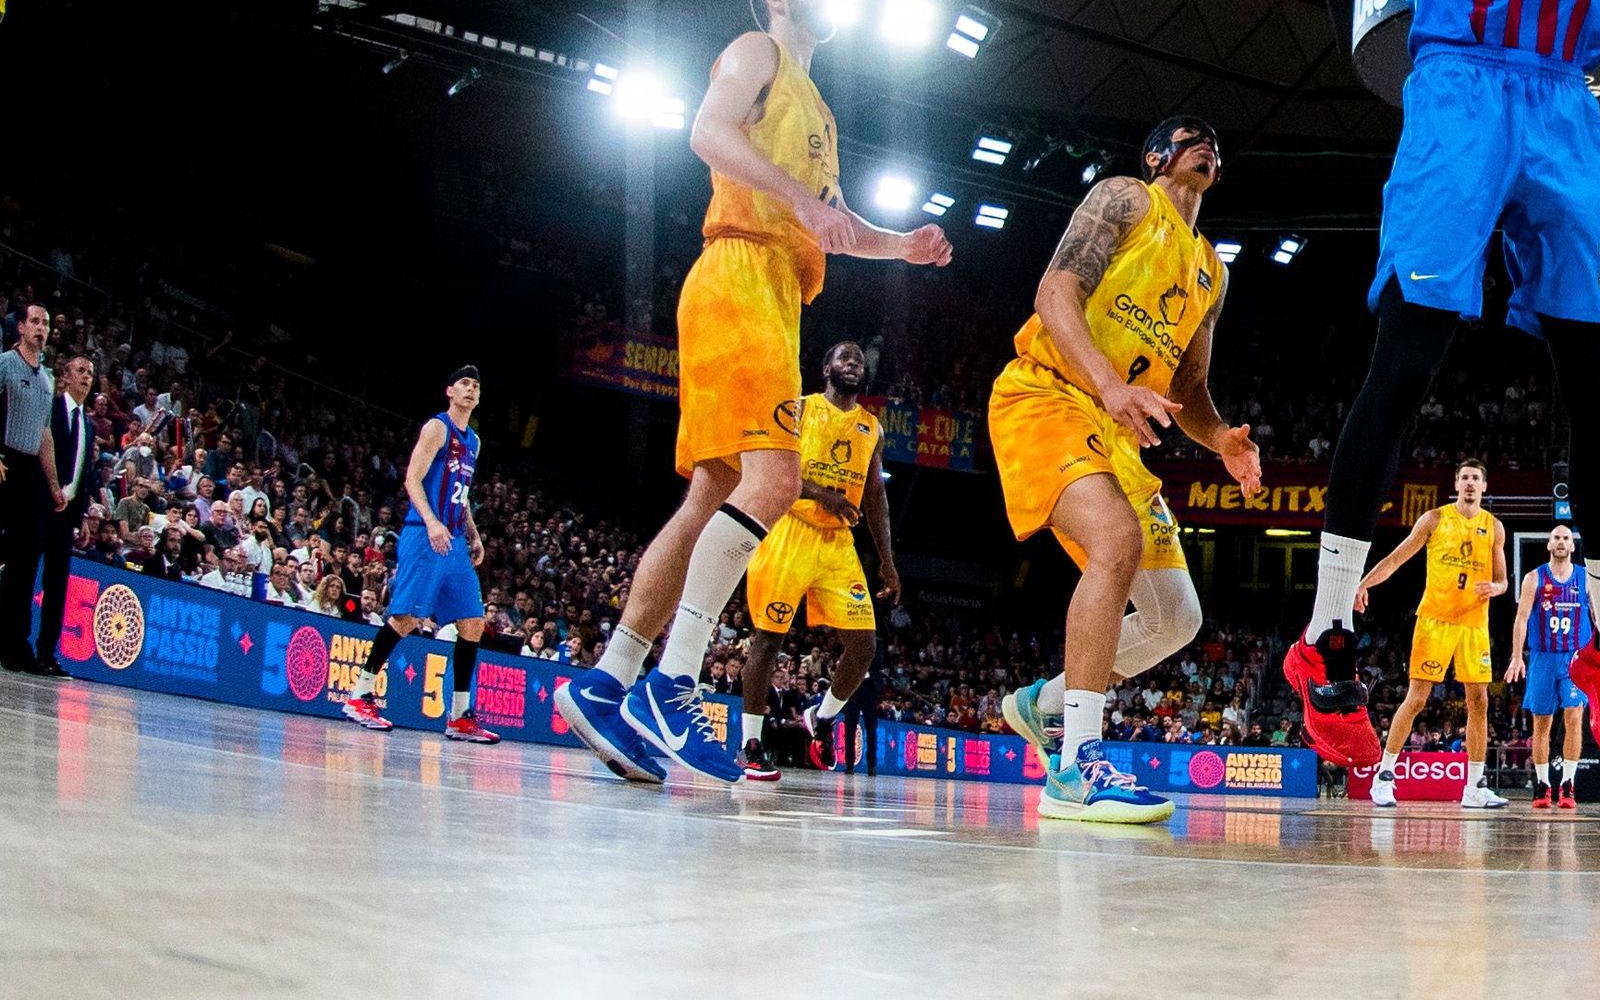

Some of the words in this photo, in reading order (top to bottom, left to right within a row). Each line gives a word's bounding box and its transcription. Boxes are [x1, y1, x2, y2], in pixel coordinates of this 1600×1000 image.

[1107, 308, 1123, 324] Isla
[1114, 293, 1182, 359] GranCana
[624, 340, 679, 377] SEMPR
[1150, 523, 1176, 535] Poe
[1457, 572, 1468, 590] 9
[1550, 616, 1571, 635] 99
[1226, 753, 1268, 767] ANYS
[1353, 757, 1466, 779] edesa
